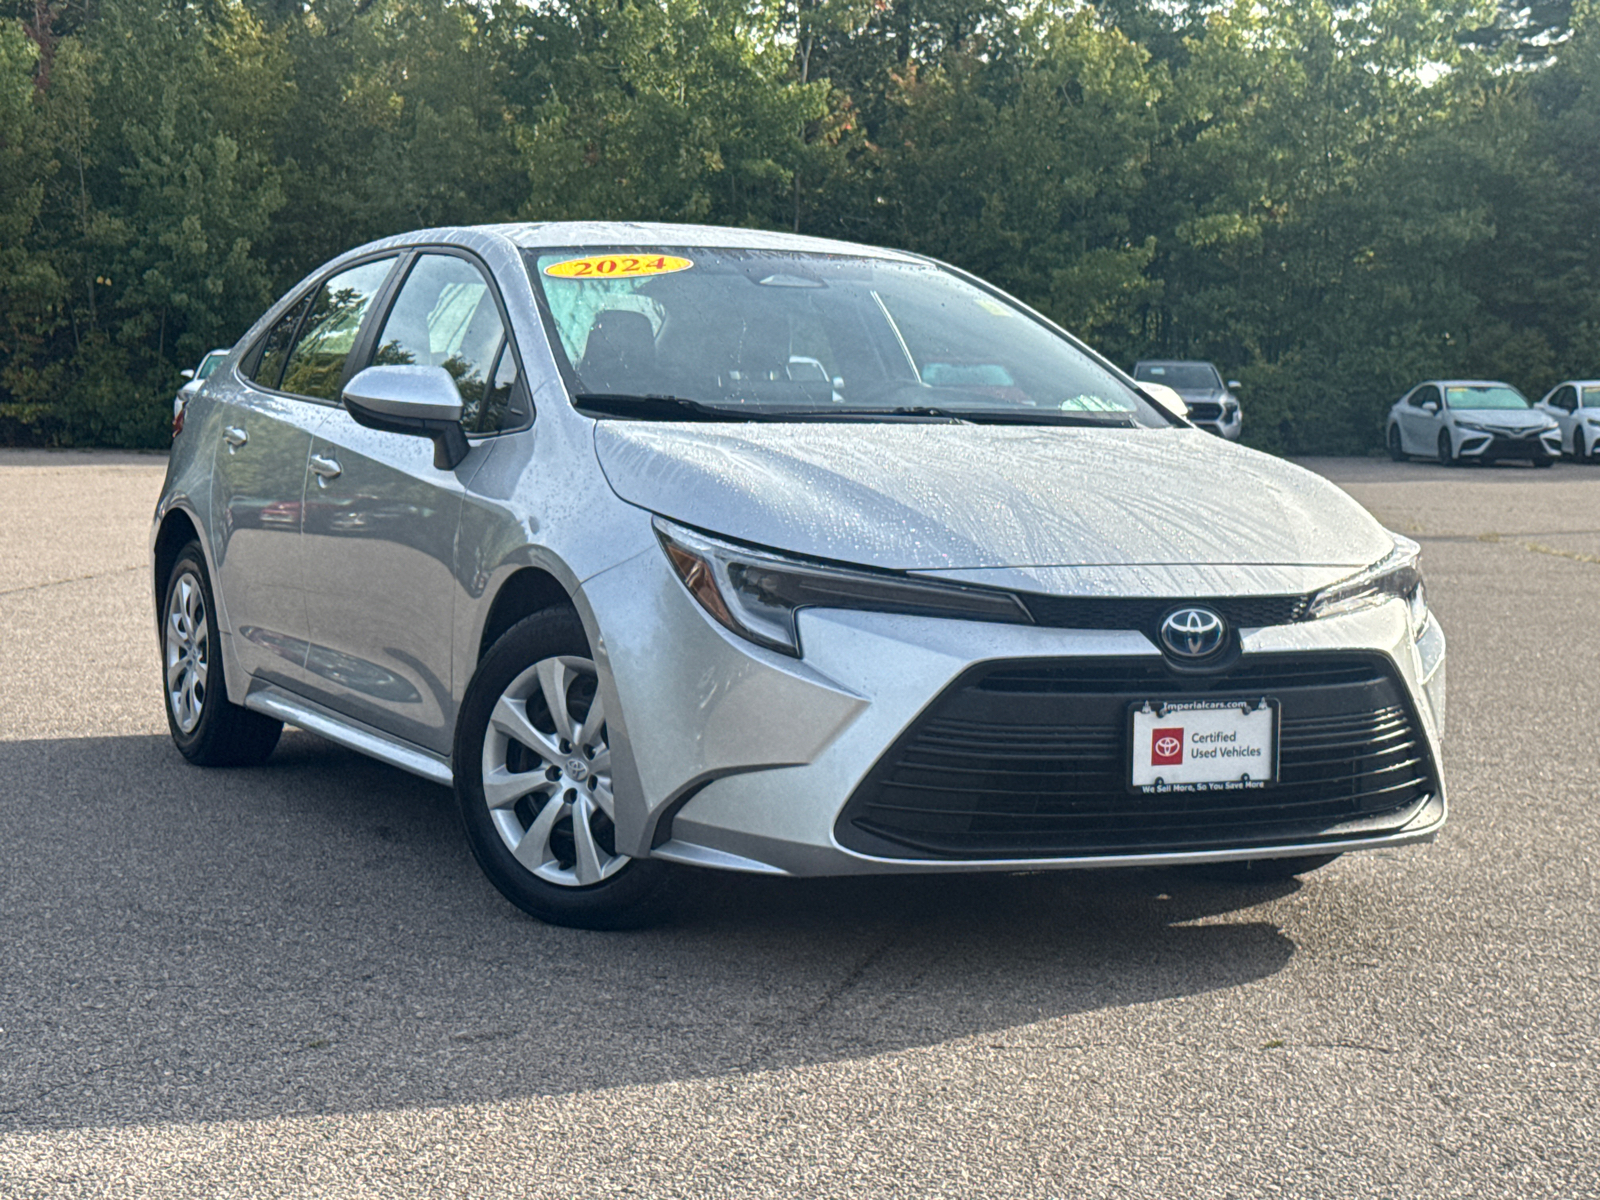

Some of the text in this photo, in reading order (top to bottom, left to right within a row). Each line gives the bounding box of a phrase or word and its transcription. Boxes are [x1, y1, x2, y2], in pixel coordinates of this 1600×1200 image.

[573, 257, 666, 276] 2024
[1163, 701, 1247, 712] Imperialcars.com
[1191, 731, 1237, 744] Certified
[1191, 745, 1261, 759] Used Vehicles
[1142, 785, 1155, 793] We
[1156, 784, 1171, 793] Sell
[1196, 783, 1207, 791] So
[1208, 782, 1223, 791] You
[1225, 781, 1243, 790] Save
[1245, 780, 1264, 789] More
